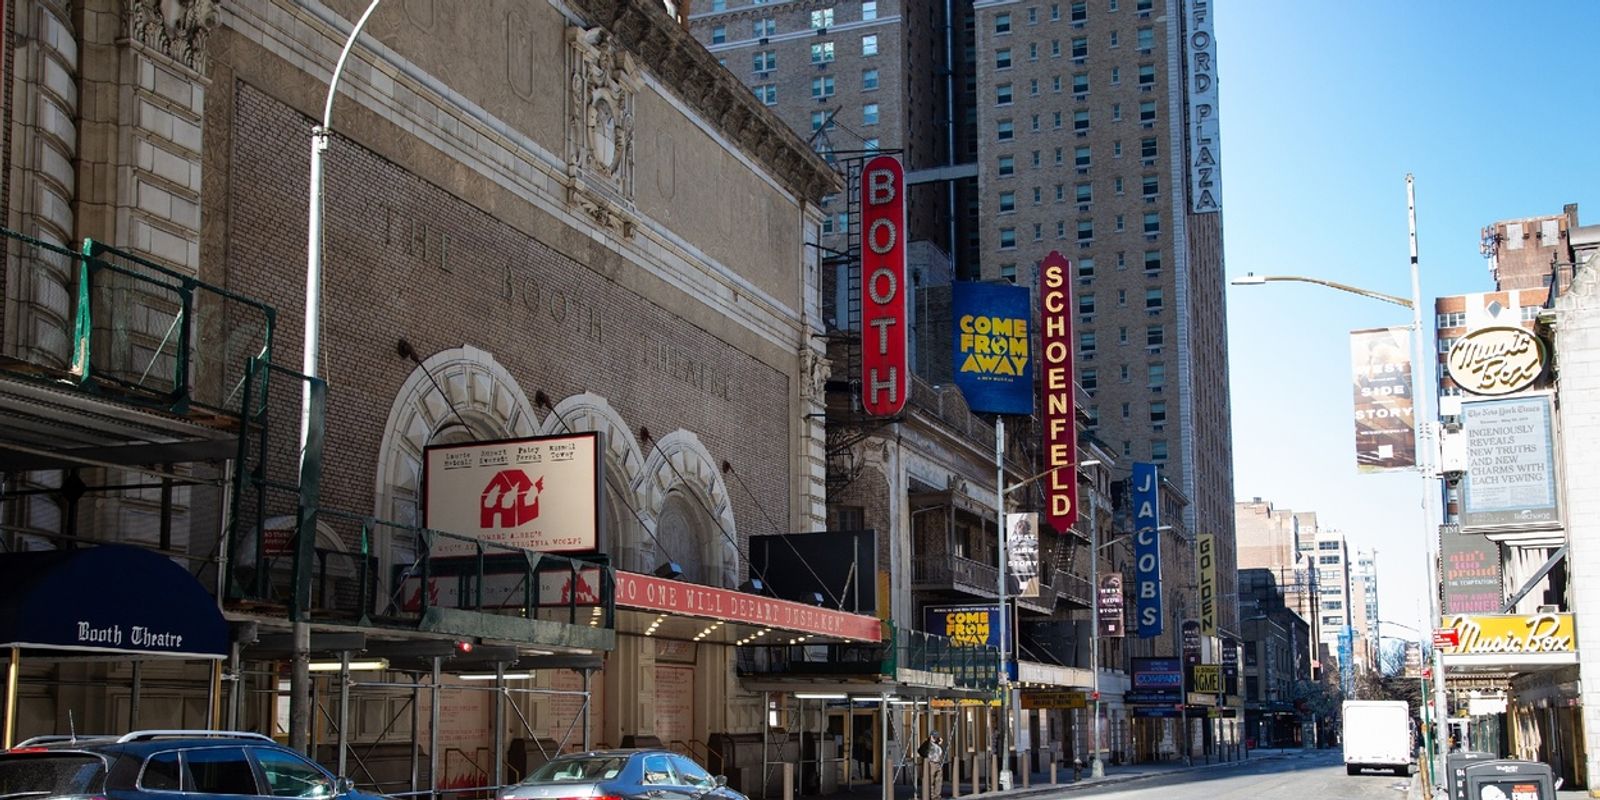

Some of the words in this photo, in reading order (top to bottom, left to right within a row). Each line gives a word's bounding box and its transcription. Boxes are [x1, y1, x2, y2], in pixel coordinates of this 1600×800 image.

[1195, 104, 1217, 210] PLAZA
[868, 169, 897, 404] BOOTH
[960, 314, 1028, 337] COME
[960, 333, 1028, 356] FROM
[1450, 331, 1532, 370] Music
[960, 354, 1029, 376] AWAY
[1472, 358, 1539, 390] Box
[1045, 266, 1071, 516] SCHOENFELD
[1361, 385, 1405, 397] SIDE
[1355, 407, 1413, 420] STORY
[1469, 424, 1535, 438] INGENIOUSLY
[1469, 435, 1515, 447] REVEALS
[1470, 446, 1493, 457] NEW
[1496, 443, 1537, 455] TRUTHS
[1471, 456, 1493, 466] AND
[1495, 455, 1519, 465] NEW
[1471, 464, 1514, 476] CHARMS
[1517, 462, 1545, 473] WITH
[1472, 475, 1499, 486] EACH
[1137, 473, 1157, 626] JACOBS
[1449, 550, 1485, 561] ain't
[1448, 565, 1497, 580] proud
[1455, 561, 1480, 570] too
[1199, 539, 1214, 633] GOLDEN
[1460, 578, 1498, 586] TEMPTATIONS
[615, 577, 637, 600] NO
[647, 583, 677, 607] ONE
[686, 588, 724, 613] WILL
[731, 596, 780, 622] DEPART
[1450, 600, 1500, 613] WINNER
[945, 611, 989, 624] COME
[77, 621, 122, 645] Booth
[131, 625, 183, 648] Theatre
[945, 623, 989, 636] FROM
[1451, 613, 1522, 654] Music
[1525, 612, 1571, 653] Box
